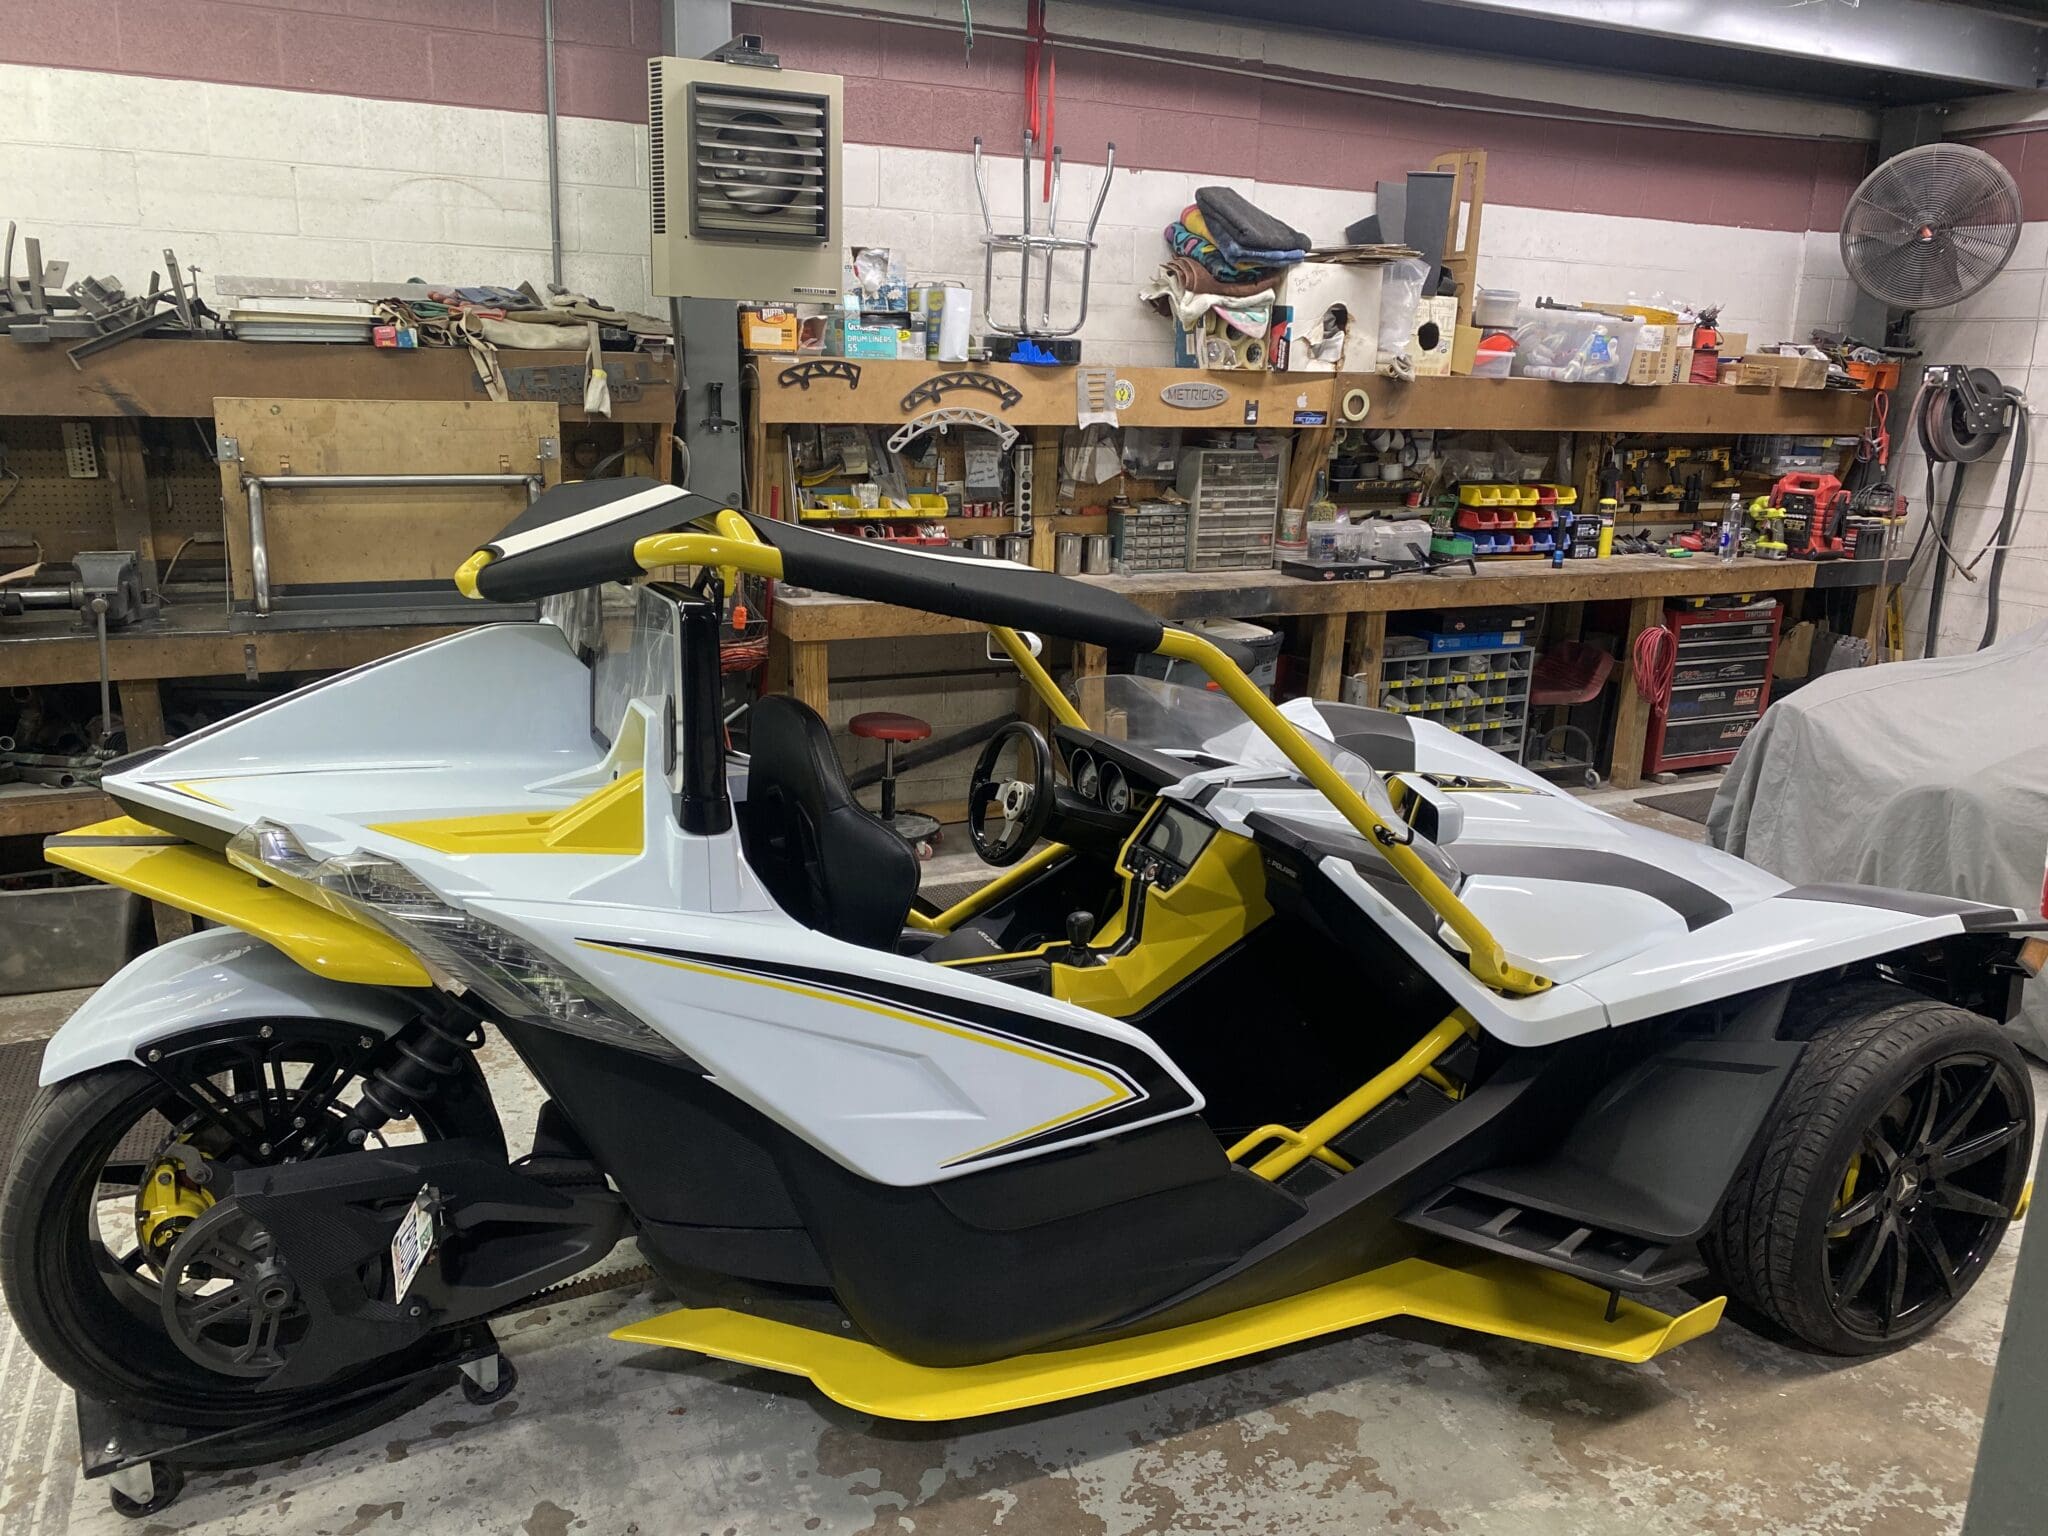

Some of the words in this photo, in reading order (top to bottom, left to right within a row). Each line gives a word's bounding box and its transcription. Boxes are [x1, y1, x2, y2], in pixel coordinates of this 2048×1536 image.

[847, 335, 869, 343] DRUM
[847, 344, 858, 352] 55
[1167, 387, 1224, 402] METRICKS
[1736, 688, 1758, 698] MSD
